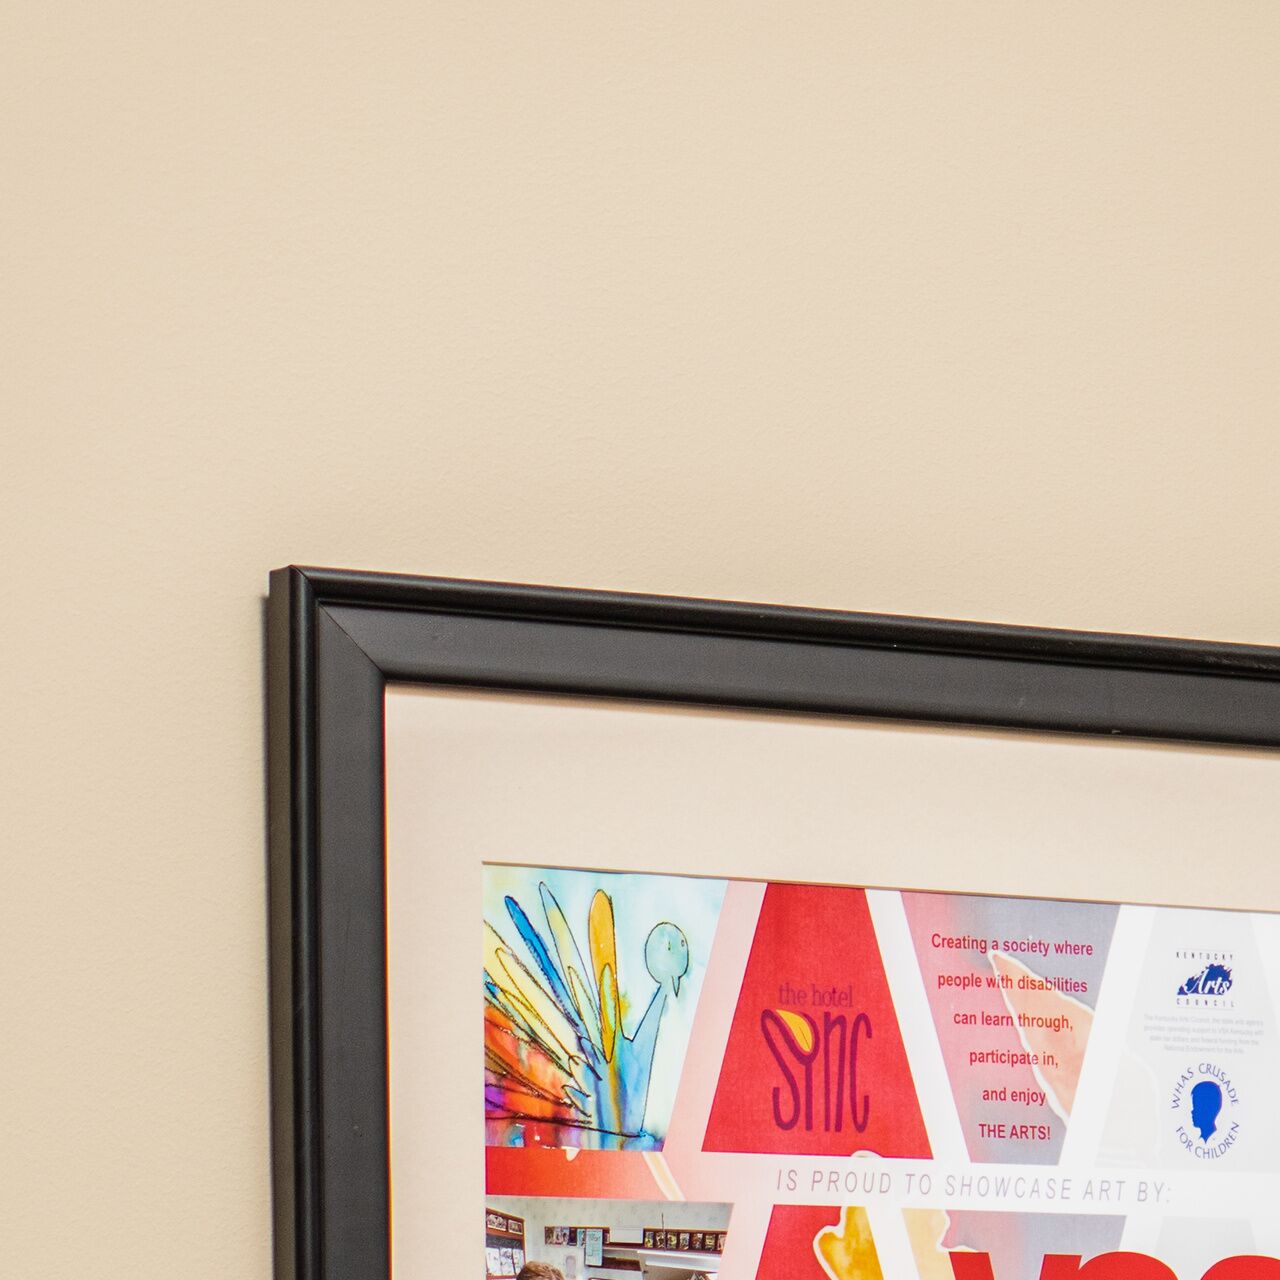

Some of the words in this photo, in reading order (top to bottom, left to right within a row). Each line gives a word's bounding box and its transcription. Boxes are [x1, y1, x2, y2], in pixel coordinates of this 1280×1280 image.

[932, 933, 987, 954] Creating
[992, 939, 999, 950] a
[1003, 939, 1049, 956] society
[1054, 941, 1093, 955] where
[1176, 951, 1234, 961] KENTUCKY
[938, 974, 982, 990] people
[986, 974, 1013, 989] with
[1018, 976, 1087, 993] disabilities
[1185, 968, 1230, 994] Arts
[954, 1013, 976, 1025] can
[982, 1012, 1013, 1026] learn
[1018, 1014, 1073, 1032] through,
[970, 1051, 1038, 1067] participate
[1043, 1052, 1058, 1068] in,
[1172, 1067, 1194, 1109] WHAS
[1198, 1063, 1239, 1105] CRUSADE
[983, 1088, 1006, 1101] and
[1011, 1090, 1045, 1105] enjoy
[979, 1124, 1005, 1138] THE
[1010, 1125, 1050, 1140] ARTS!
[1176, 1126, 1193, 1152] FOR
[1195, 1121, 1239, 1159] CHILDREN
[777, 1169, 798, 1191] IS
[811, 1170, 891, 1194] PROUD
[906, 1173, 932, 1195] TO
[945, 1174, 1072, 1199] SHOWCASE
[1083, 1179, 1125, 1201] ART
[1138, 1181, 1172, 1204] BY:
